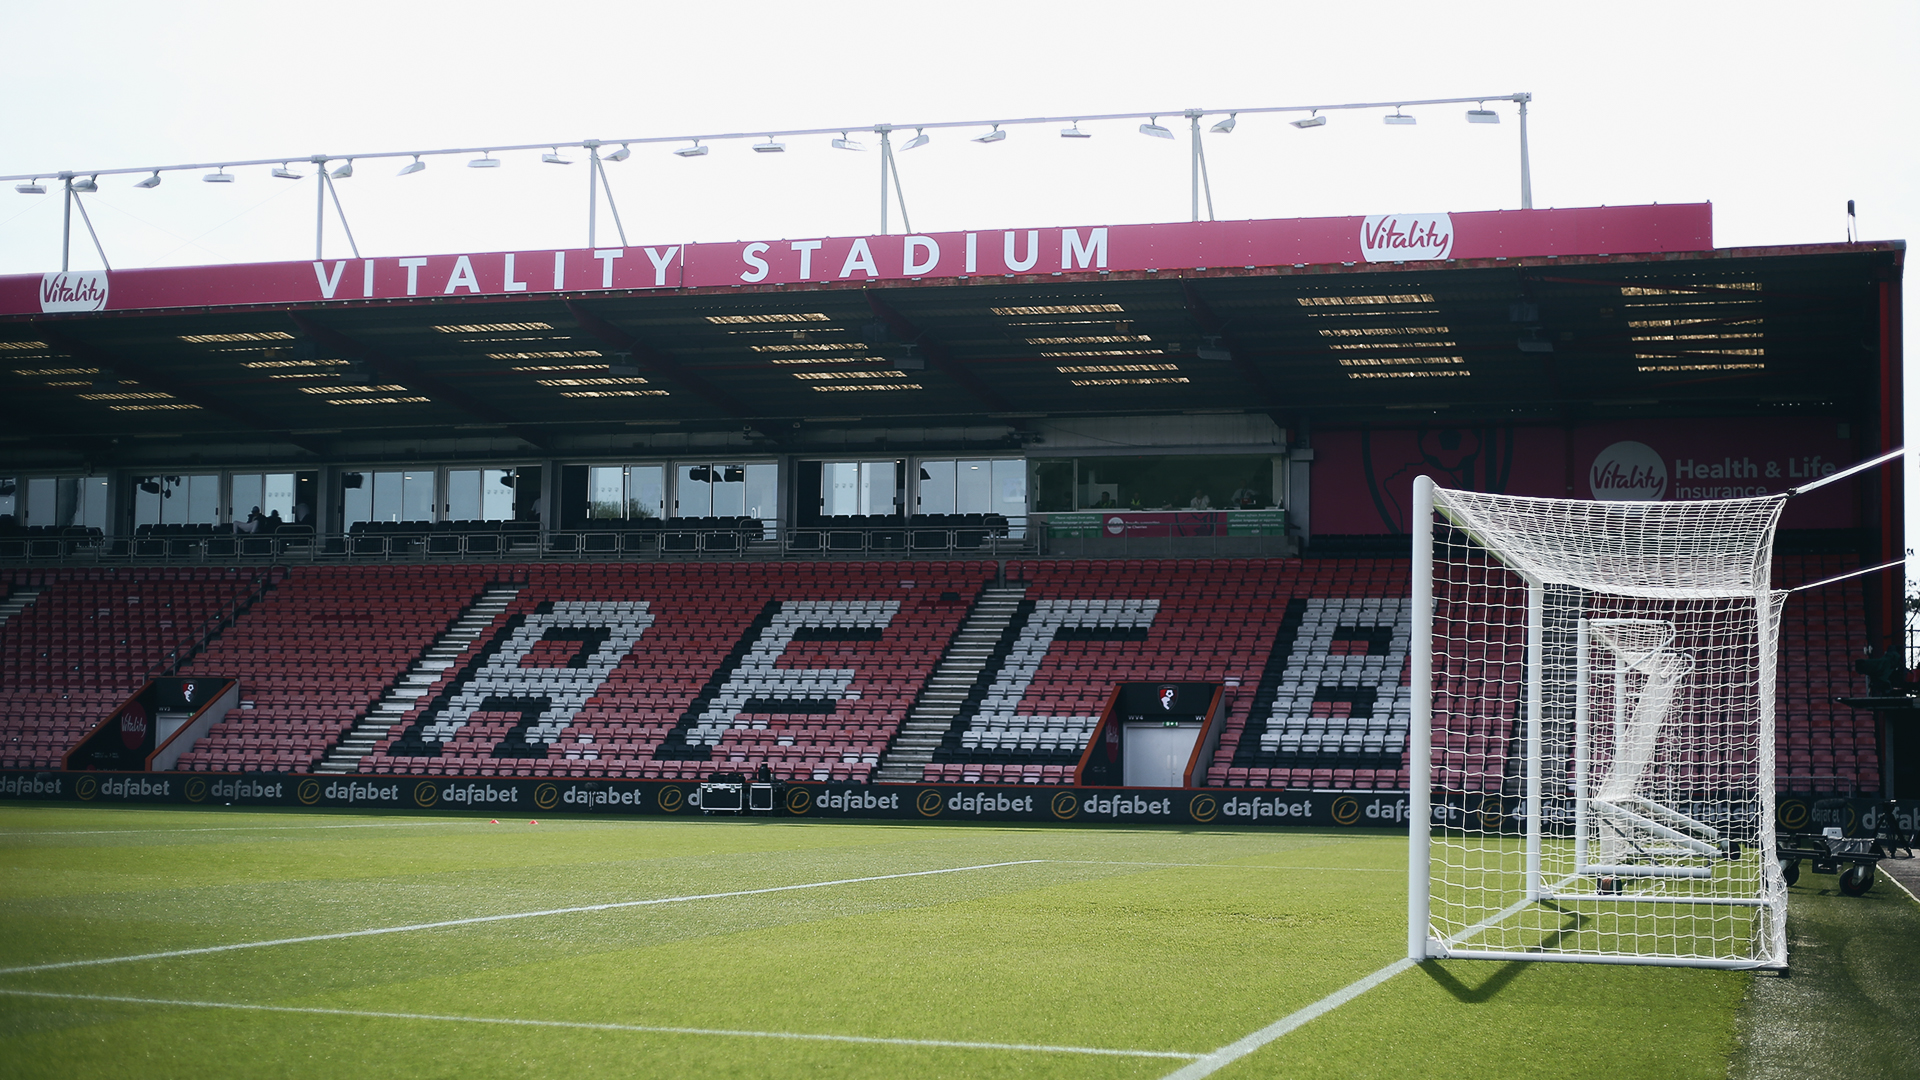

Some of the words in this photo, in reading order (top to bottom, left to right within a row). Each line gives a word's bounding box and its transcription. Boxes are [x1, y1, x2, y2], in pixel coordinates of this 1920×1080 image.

[1365, 215, 1449, 257] Vitality
[312, 246, 680, 300] VITALITY
[740, 227, 1108, 284] STADIUM
[44, 272, 105, 310] Vitality
[1593, 459, 1665, 498] Vitality
[1676, 456, 1758, 479] Health
[1765, 459, 1782, 479] &
[1789, 455, 1837, 478] Life
[1675, 483, 1768, 499] insurance
[101, 778, 170, 798] dafabet
[211, 779, 283, 800] dafabet
[325, 781, 399, 802] dafabet
[442, 783, 518, 805] dafabet
[816, 788, 899, 812] dafabet
[948, 790, 1033, 814] dafabet
[1083, 793, 1171, 817] dafabet
[1222, 795, 1312, 820] dafabet
